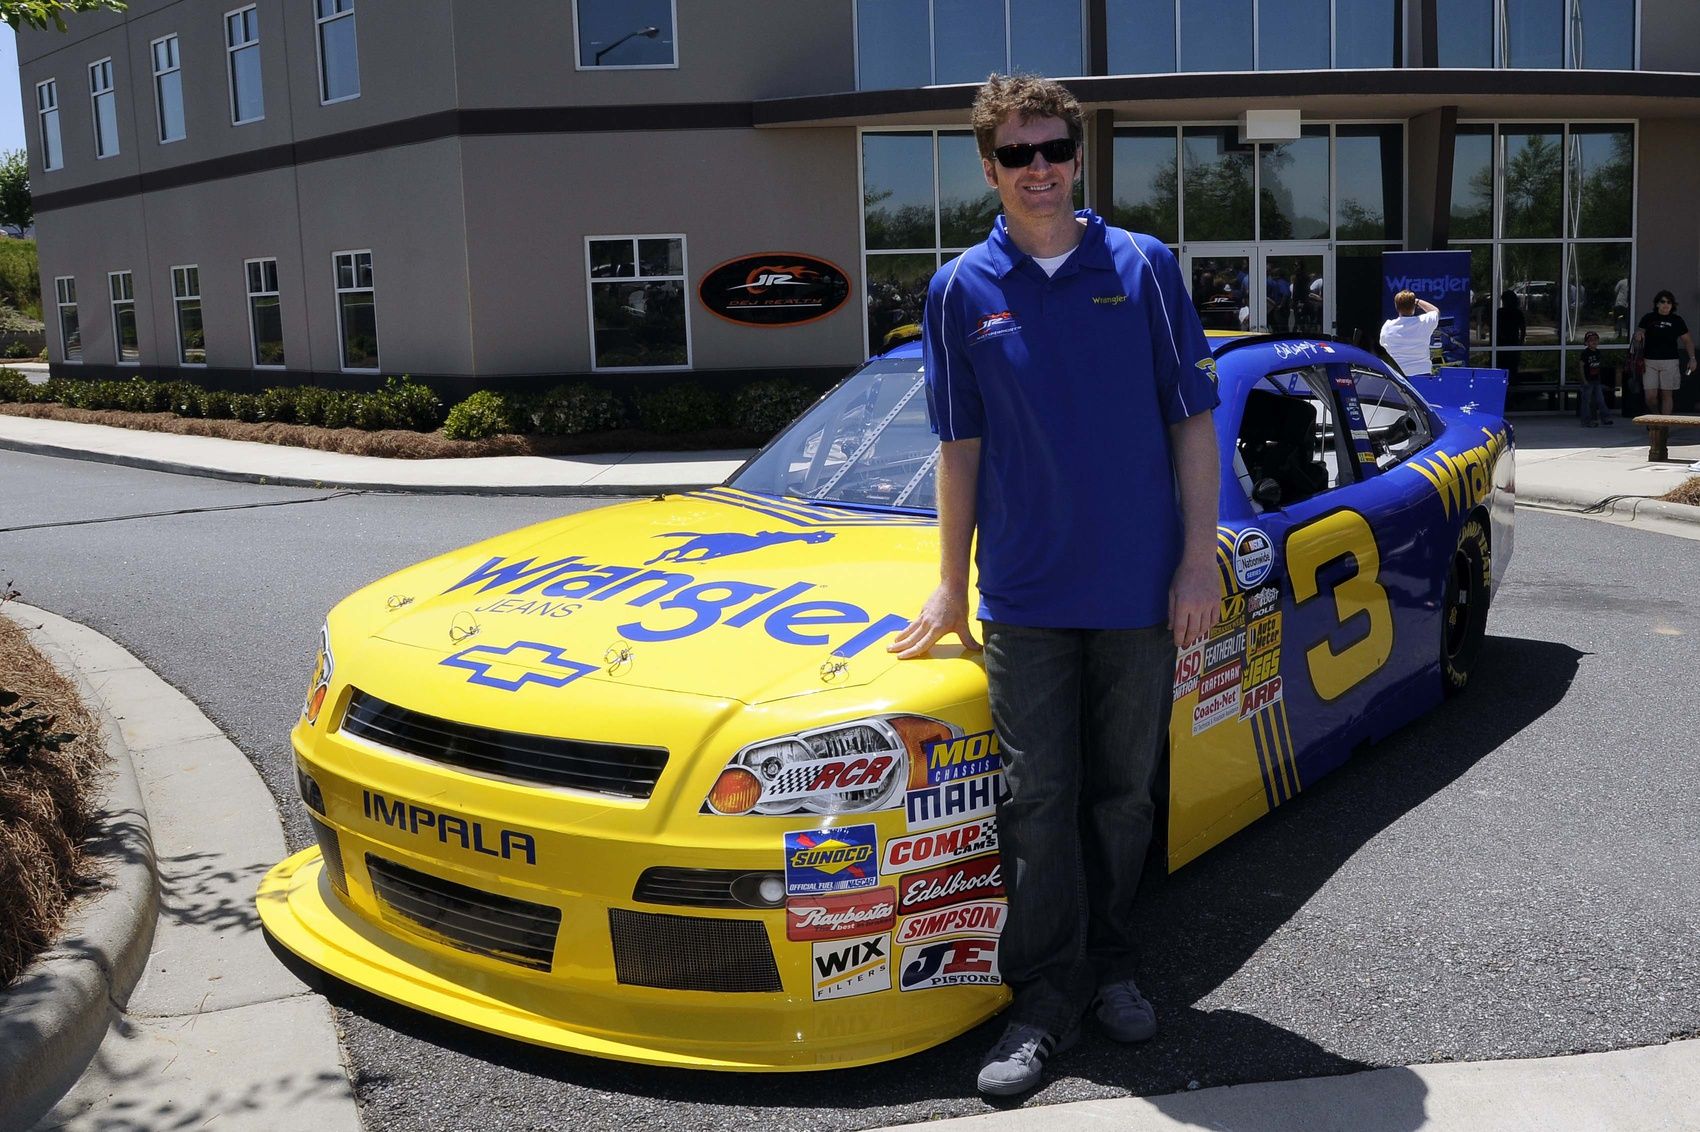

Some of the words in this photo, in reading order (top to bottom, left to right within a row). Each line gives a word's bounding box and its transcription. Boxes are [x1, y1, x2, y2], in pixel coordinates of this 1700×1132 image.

[1092, 295, 1128, 306] Wrangler
[1385, 275, 1470, 299] Wrangler
[1242, 552, 1270, 569] Nationwide
[1246, 569, 1262, 578] SERIES
[441, 556, 911, 659] Wrangler
[475, 598, 582, 618] JEANS
[1252, 604, 1275, 619] POLE
[1286, 510, 1393, 701] 3
[1257, 619, 1276, 635] Auto
[1204, 632, 1246, 668] FEATHERLITE
[1201, 667, 1240, 693] CRAFTSMAN
[1243, 650, 1280, 691] JEGS
[1194, 691, 1236, 721] Coach-Net
[1240, 678, 1281, 716] ARP
[809, 756, 893, 791] RCR
[935, 759, 990, 782] CHASSIS
[363, 790, 537, 865] IMPALA
[794, 846, 870, 866] SUNOCO
[889, 825, 981, 866] COMP
[953, 838, 997, 856] CAMS
[789, 882, 817, 891] OFFICIAL
[819, 881, 834, 889] FUEL
[903, 864, 1002, 906] Edelbrock
[788, 902, 894, 931] Raybestos
[837, 923, 855, 931] best
[904, 907, 1001, 939] SIMPSON
[815, 936, 885, 978] WIX
[902, 940, 997, 987] JE
[817, 964, 886, 997] FILTERS
[931, 974, 1000, 985] PISTONS
